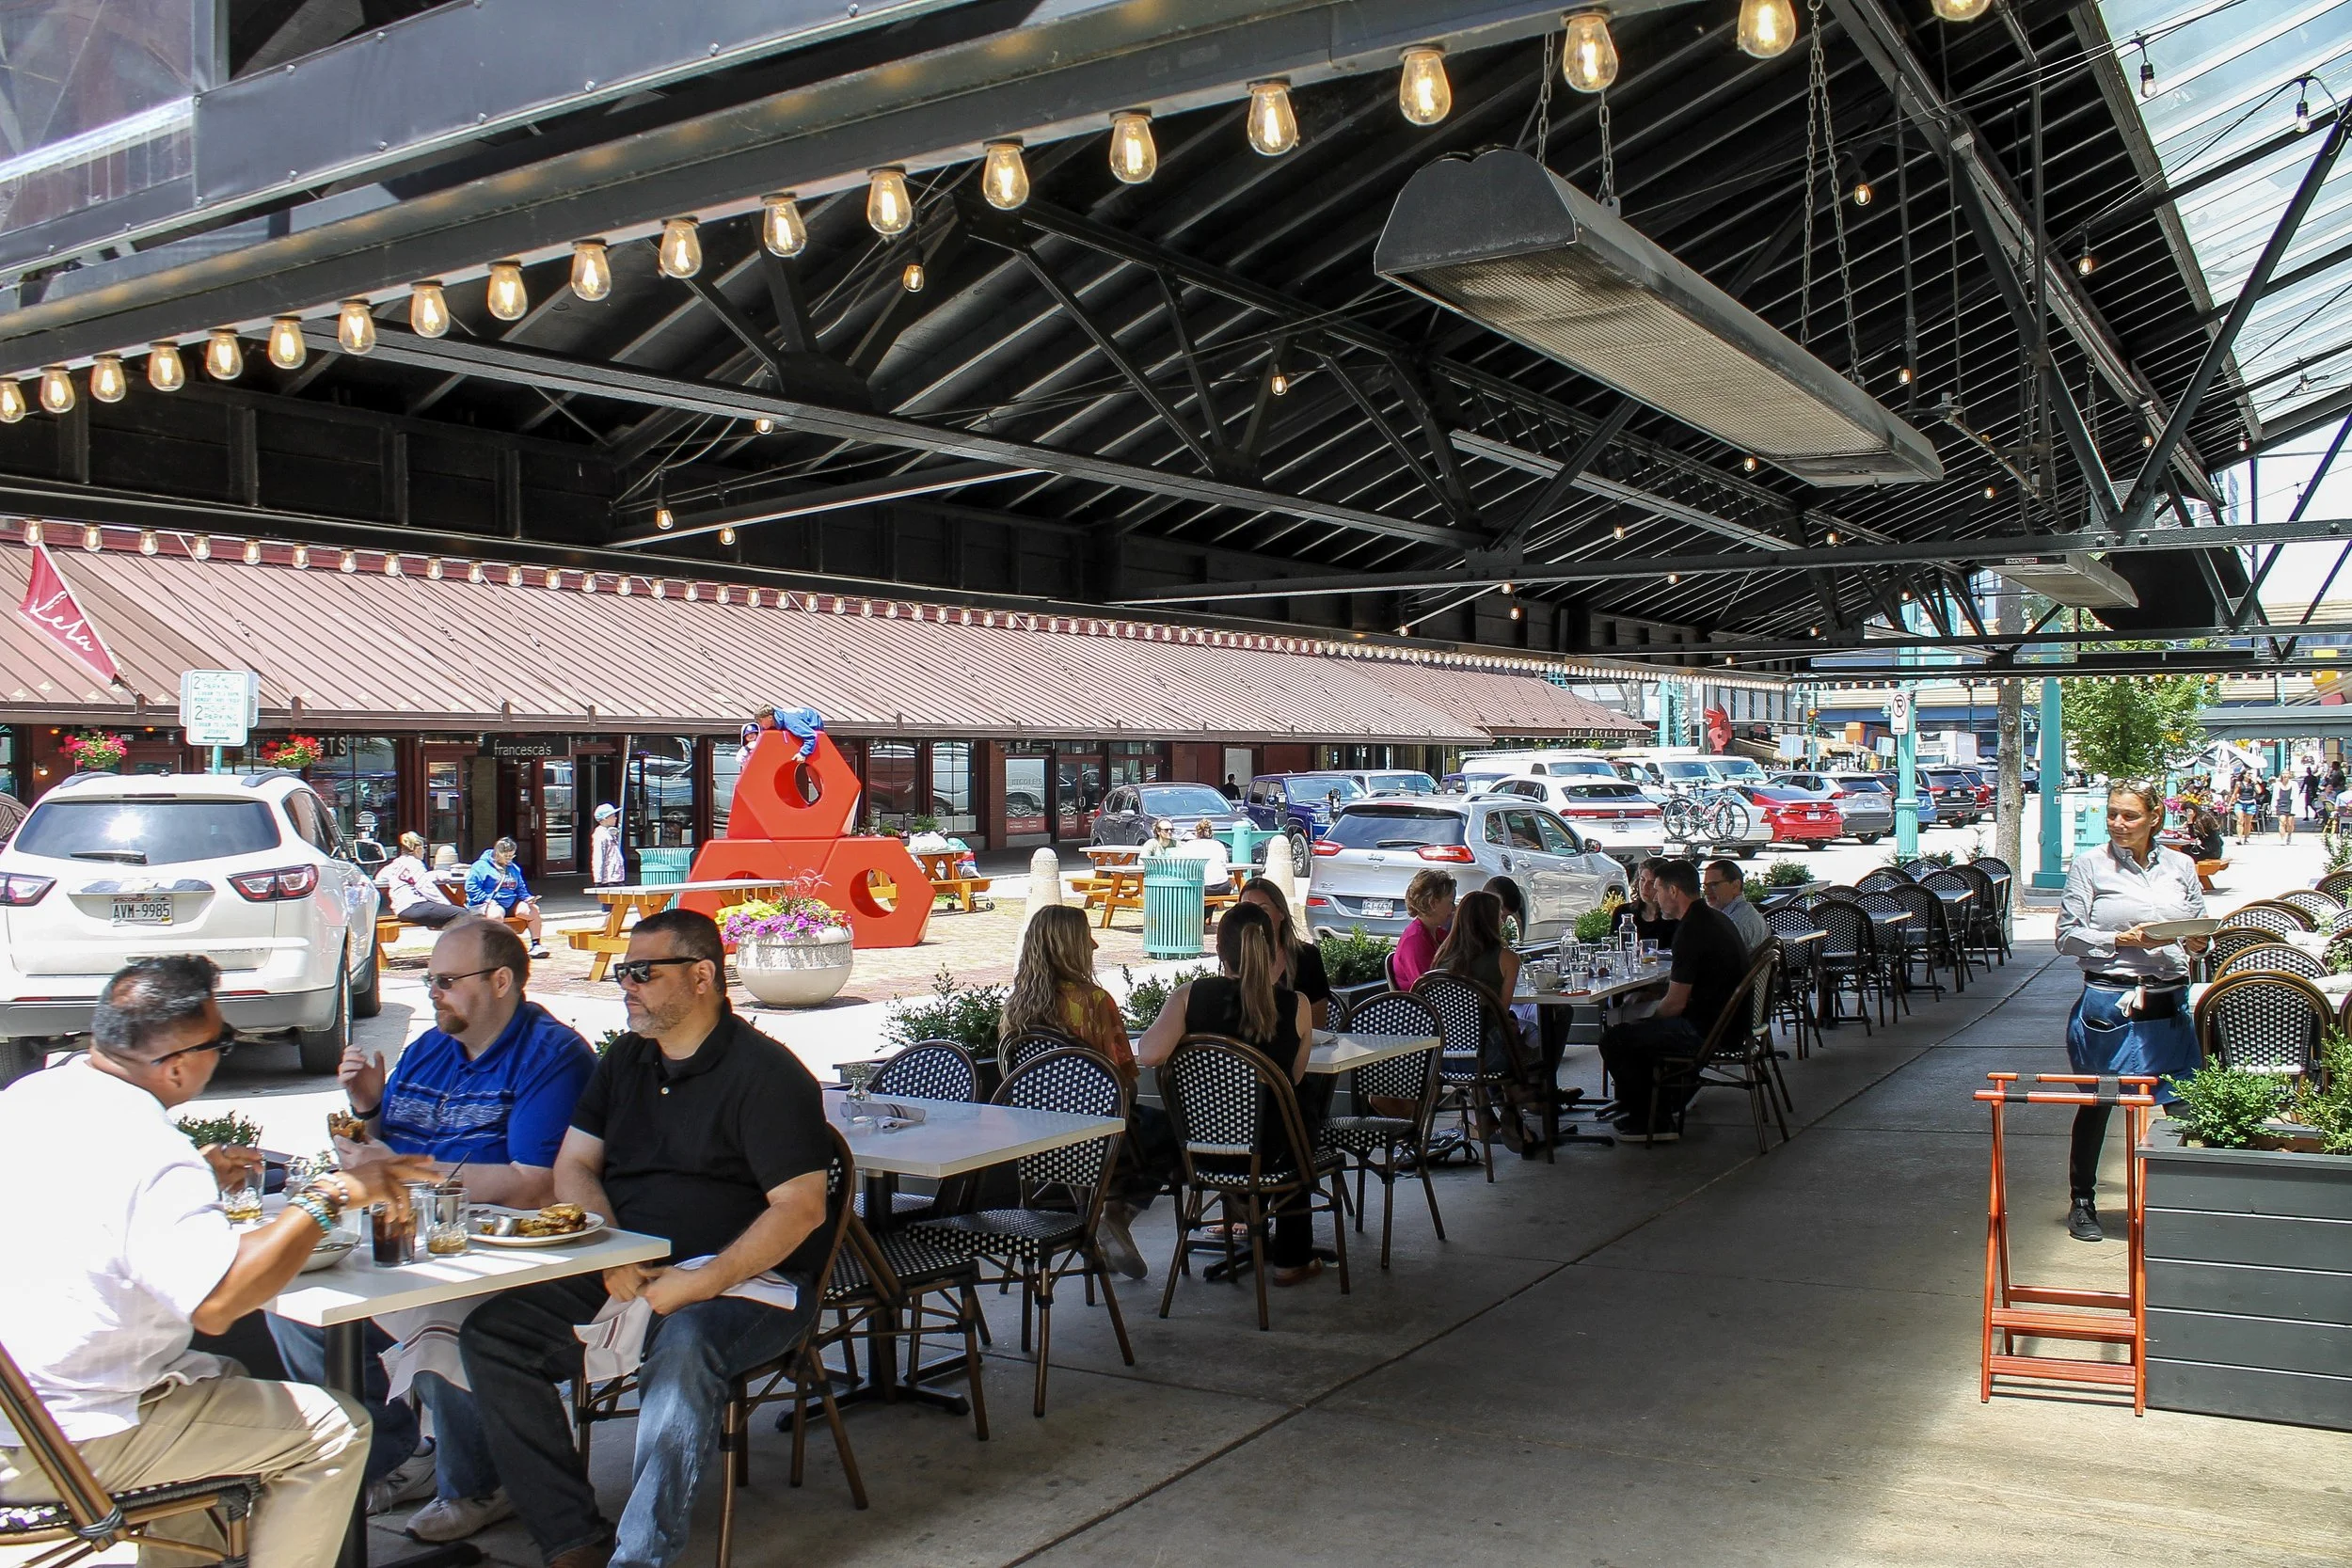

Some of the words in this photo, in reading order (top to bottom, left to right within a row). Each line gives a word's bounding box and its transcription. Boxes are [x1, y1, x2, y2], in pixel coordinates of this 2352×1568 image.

[193, 675, 201, 689] 2
[194, 705, 203, 721] 2
[494, 739, 552, 755] francesca's
[113, 903, 171, 918] AVM-9985
